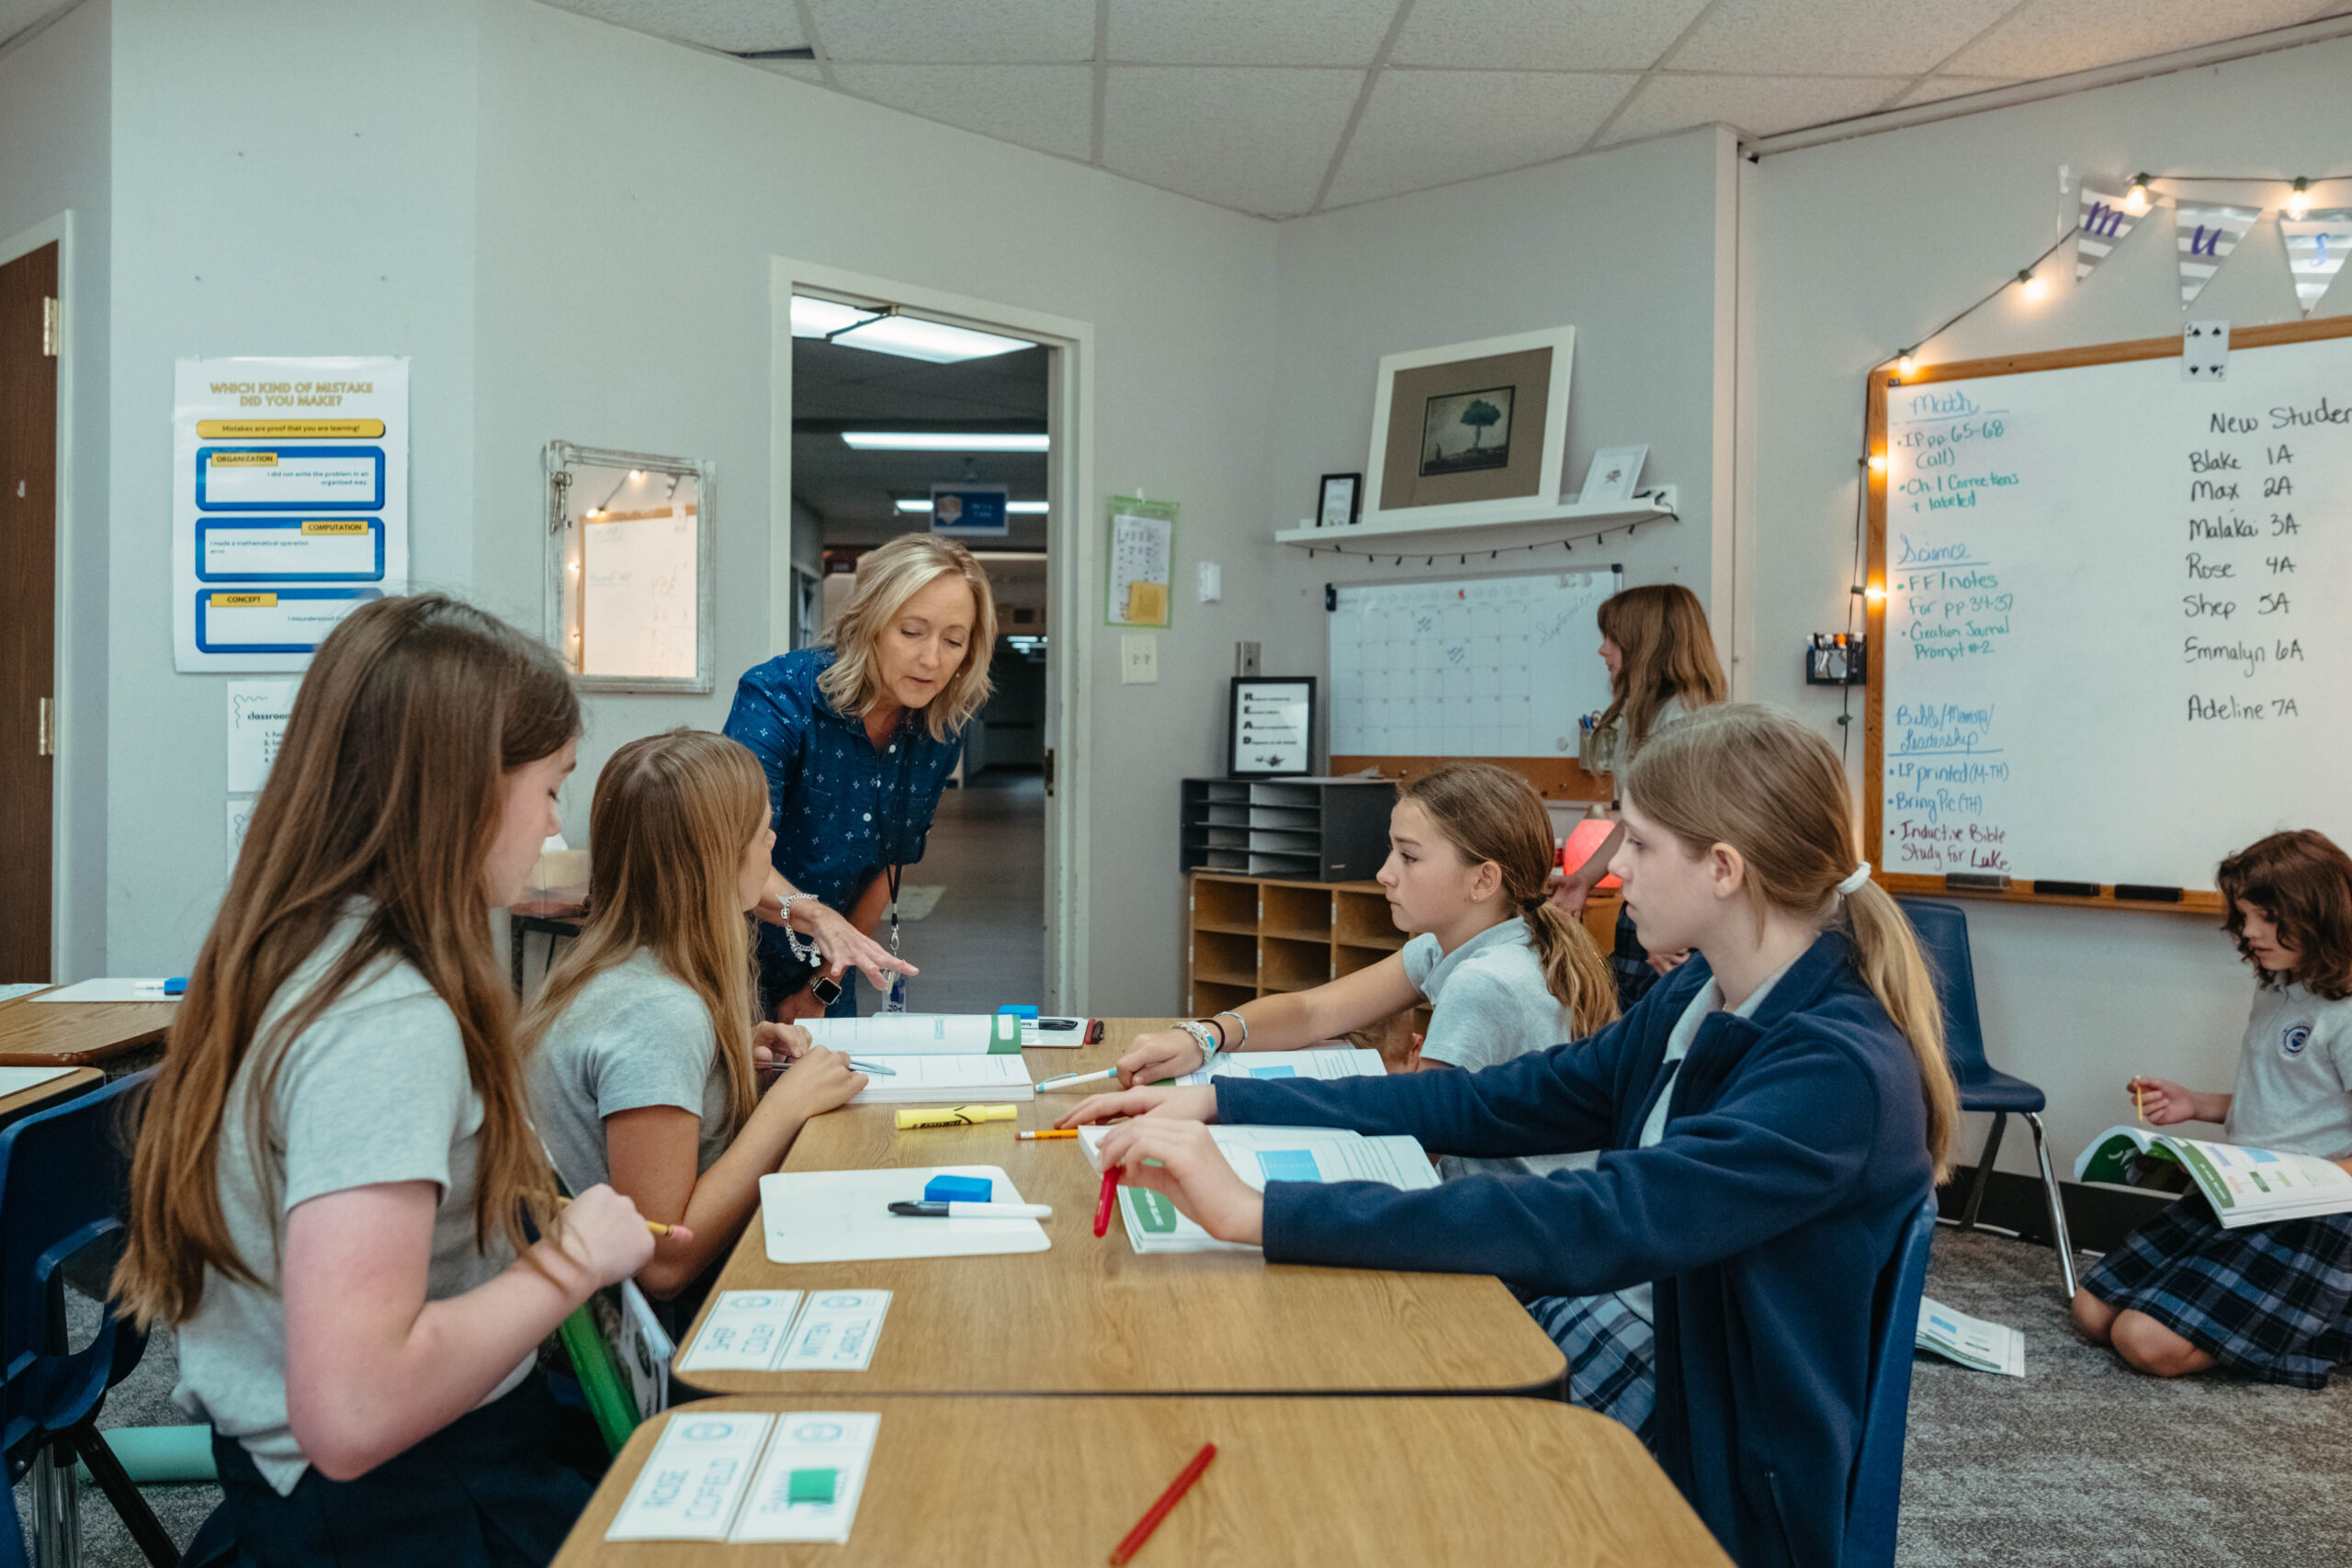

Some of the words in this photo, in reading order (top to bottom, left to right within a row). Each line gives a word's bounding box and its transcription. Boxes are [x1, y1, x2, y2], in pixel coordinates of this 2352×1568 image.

[209, 381, 254, 394] WHICH
[258, 381, 291, 394] KIND
[294, 381, 313, 394] OF
[315, 381, 373, 394] MISTAKE
[239, 394, 263, 407] DID
[266, 394, 295, 407] YOU
[297, 394, 344, 407] MAKE?
[1911, 389, 1981, 415] Math
[267, 424, 286, 433] proof
[330, 424, 361, 433] learning!
[1951, 419, 2004, 443] 65-68
[2210, 412, 2258, 434] New
[216, 455, 274, 463] ORGANIZATION
[2188, 450, 2242, 474] Blake
[2267, 444, 2294, 466] 1A
[1949, 470, 2019, 491] Corrections
[2190, 479, 2240, 502] Max
[2263, 476, 2293, 498] 2A
[1928, 489, 1977, 511] labeled
[308, 524, 362, 532] COMPUTATION
[2269, 513, 2301, 536] 3A
[1897, 533, 1973, 566] Science
[2185, 552, 2236, 579] Rose
[2266, 556, 2297, 575] 4A
[227, 595, 261, 604] CONCEPT
[1907, 598, 1938, 615] for
[2182, 592, 2236, 619] Shep
[2257, 592, 2290, 615] 5A
[1910, 620, 1962, 642] Creation
[1964, 615, 2009, 637] Journal
[1914, 641, 1964, 661] Prompt
[2184, 636, 2266, 678] Emmalyn
[2274, 639, 2304, 662] 6A
[2188, 694, 2266, 721] Adeline
[2271, 698, 2299, 717] 7A
[1900, 727, 1978, 756] Leadership
[1895, 790, 1938, 824] Bring
[1900, 819, 1963, 842] Inductive
[1970, 823, 2006, 844] Bible
[1901, 843, 1942, 872] Study
[1947, 843, 1966, 863] for
